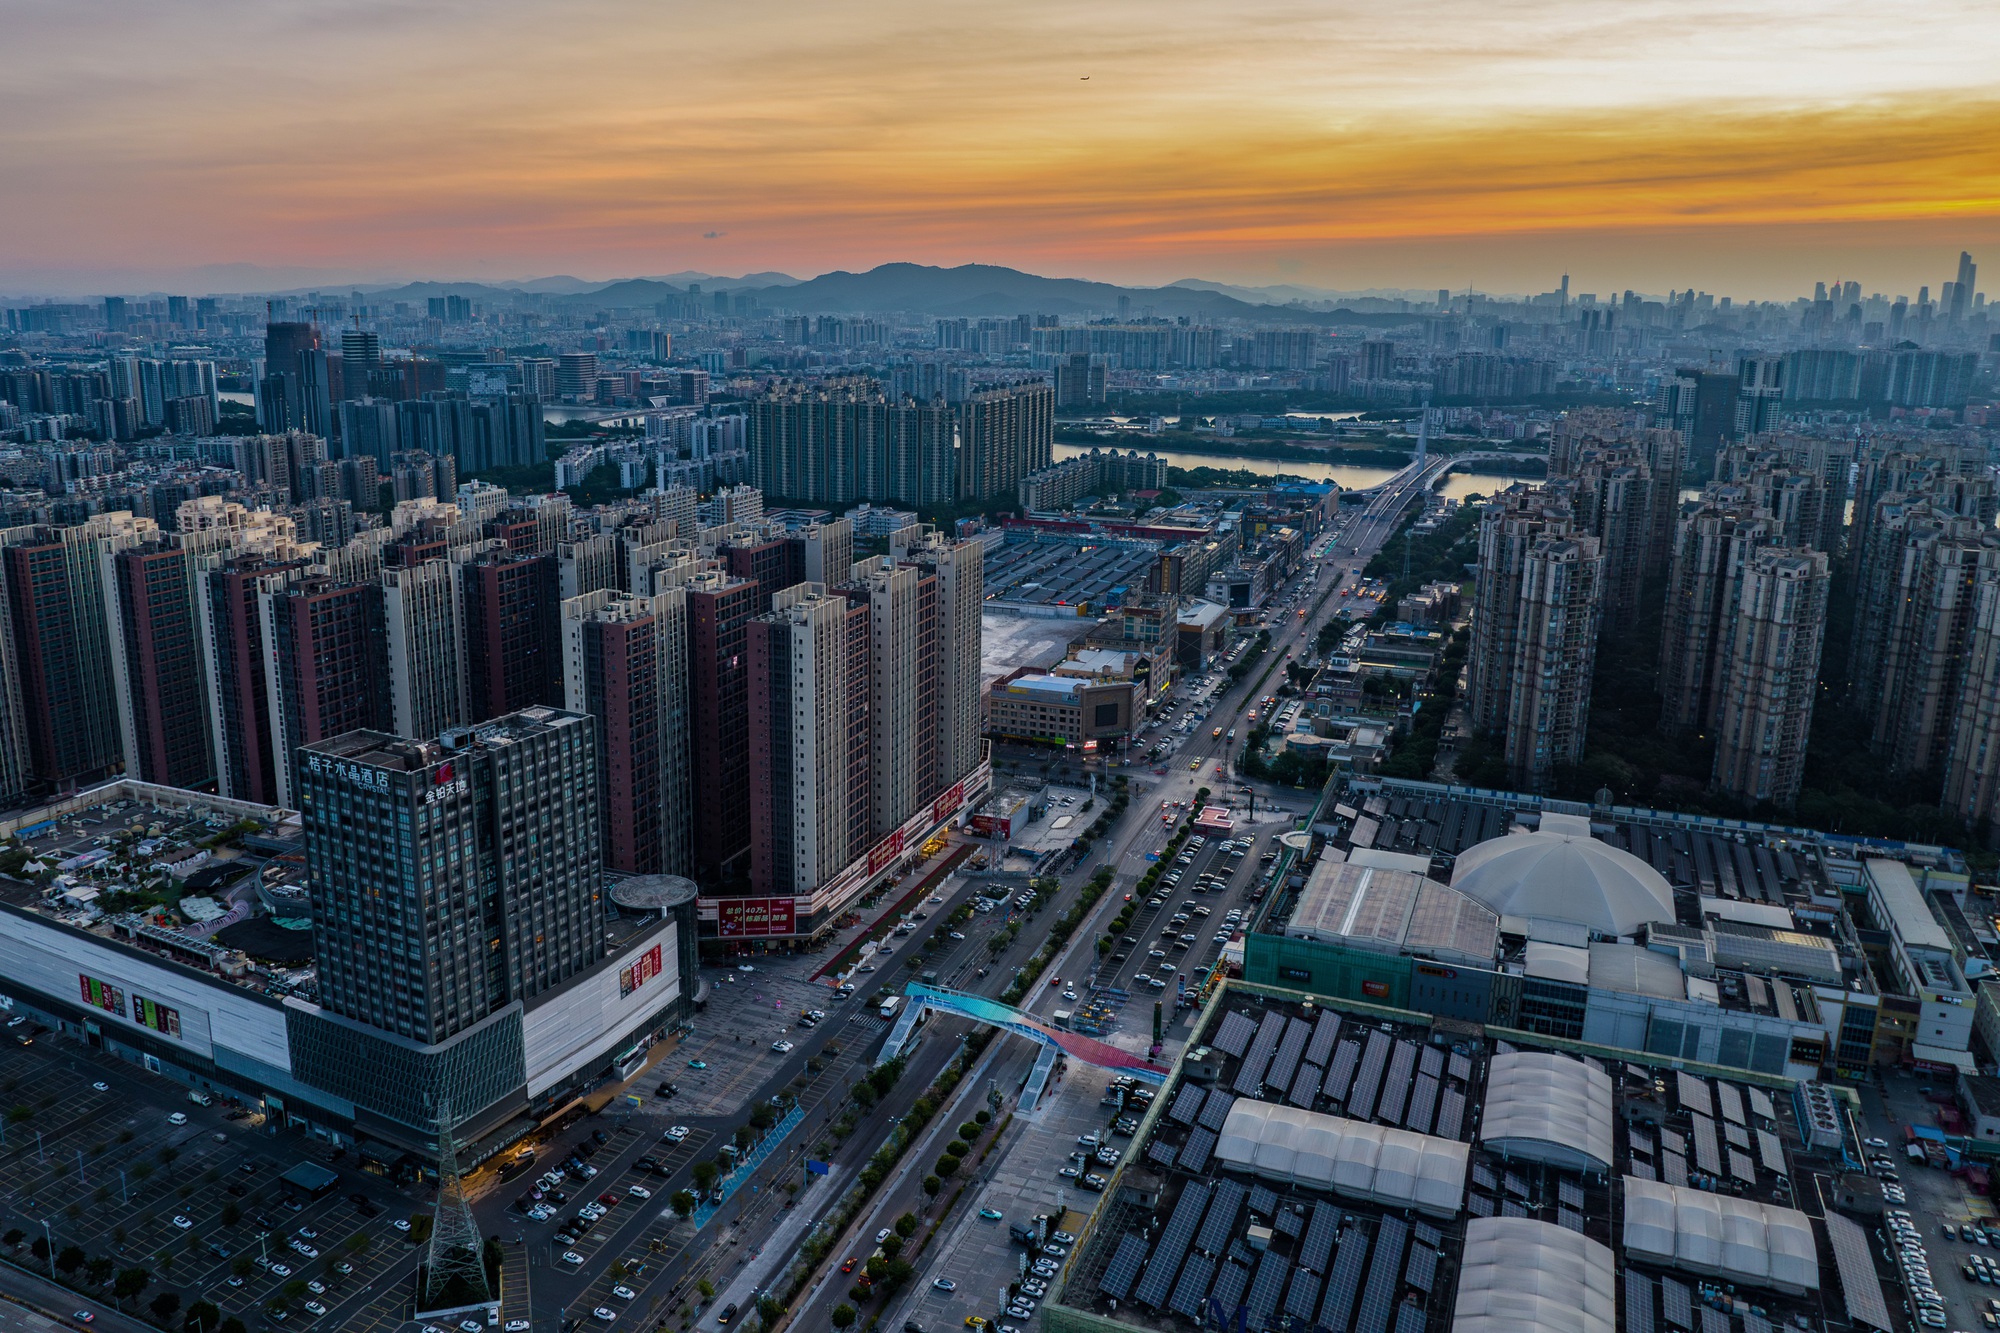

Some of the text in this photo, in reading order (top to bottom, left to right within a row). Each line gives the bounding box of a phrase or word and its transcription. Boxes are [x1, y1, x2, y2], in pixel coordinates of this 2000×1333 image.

[308, 755, 389, 787] 桔子水晶酒店
[358, 782, 390, 796] CRYSTAL
[425, 779, 467, 804] 金铂天地
[505, 1126, 531, 1145] CRYSTAL
